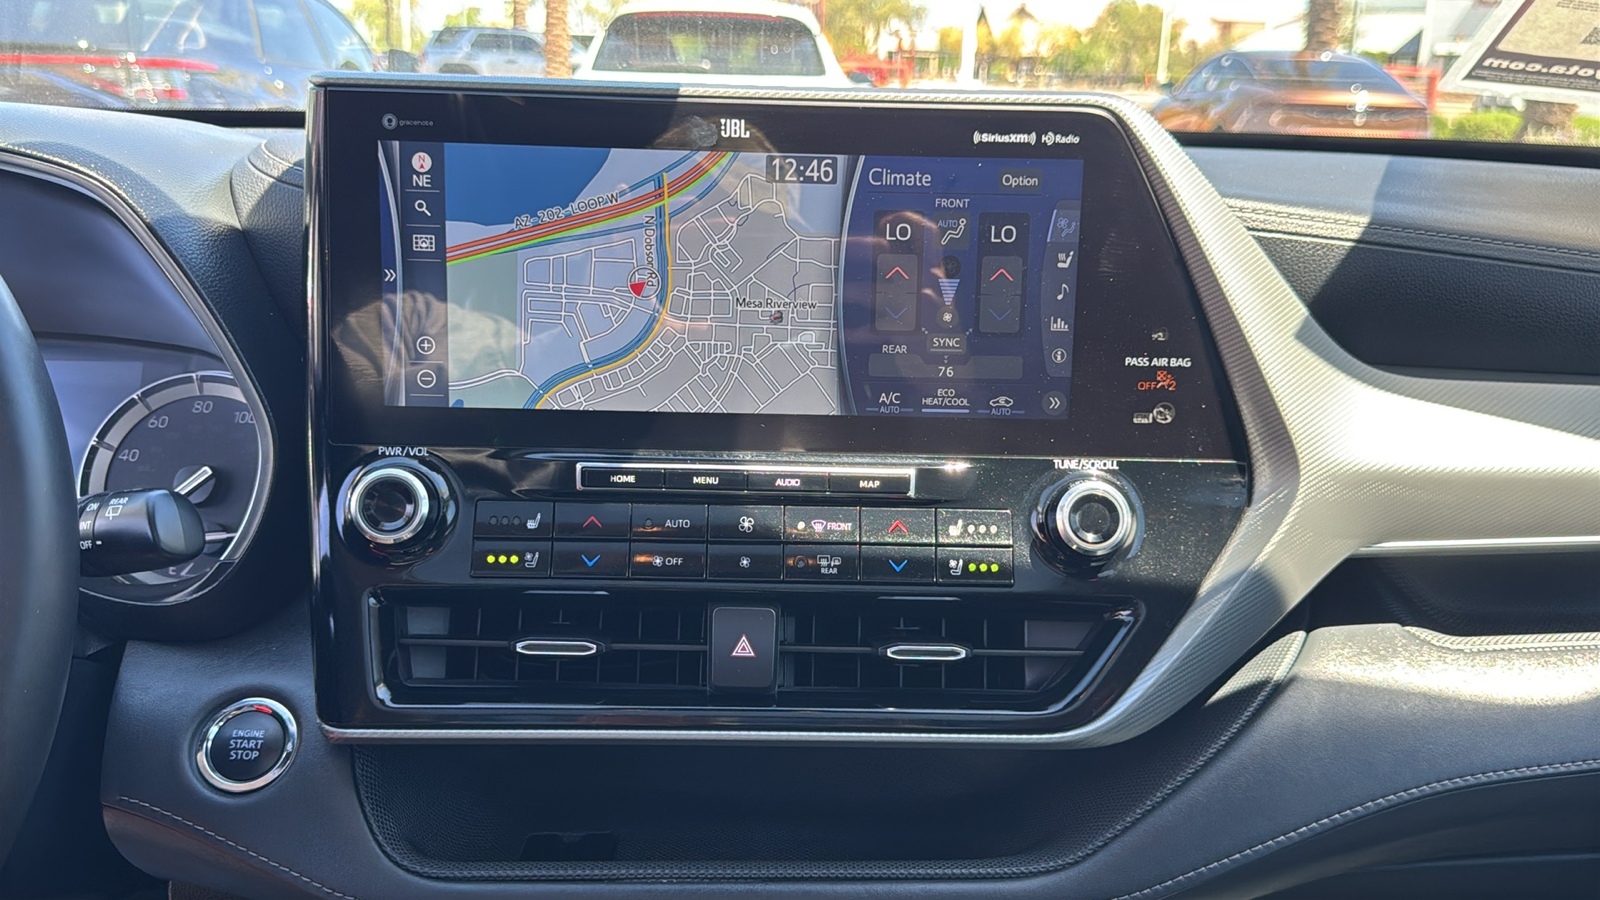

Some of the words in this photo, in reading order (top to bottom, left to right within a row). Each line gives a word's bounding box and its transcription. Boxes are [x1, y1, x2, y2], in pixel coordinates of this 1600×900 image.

[399, 119, 434, 127] gracenote
[720, 118, 751, 139] JBL
[1055, 133, 1080, 144] Radio
[417, 154, 426, 163] N
[771, 158, 834, 183] 12:46
[412, 174, 432, 188] NE
[868, 167, 932, 187] Climate
[1002, 173, 1039, 188] Option
[606, 191, 620, 205] W
[935, 198, 970, 208] FRONT
[644, 215, 655, 225] N
[938, 218, 958, 228] AUTO
[886, 223, 912, 241] LO
[990, 225, 1017, 243] LO
[644, 228, 656, 269] Dobson
[646, 271, 658, 287] Rd
[735, 298, 763, 309] Mesa
[765, 298, 818, 310] Riverview
[933, 337, 961, 348] SYNC
[882, 344, 908, 354] REAR
[1124, 357, 1149, 367] PASS
[1150, 357, 1169, 367] AIR
[1169, 358, 1192, 368] BAG
[937, 366, 954, 378] 76
[1137, 381, 1157, 391] OFF
[878, 391, 901, 405] A/C
[937, 388, 955, 397] ECO
[191, 400, 214, 414] 80
[921, 396, 970, 407] HEAT/COOL
[879, 404, 900, 414] AUTO
[990, 406, 1012, 416] AUTO
[147, 415, 169, 429] 60
[118, 448, 140, 462] 40
[377, 446, 430, 457] PWR/VOL
[1052, 459, 1120, 470] TUNE/SCROLL
[609, 474, 636, 483] HOME
[692, 475, 719, 485] MENU
[775, 478, 801, 487] AUDIO
[859, 480, 881, 489] MAP
[86, 502, 100, 512] ON
[108, 497, 129, 506] REAR
[664, 518, 691, 529] AUTO
[826, 521, 853, 531] FRONT
[79, 540, 93, 550] OFF
[665, 556, 684, 566] OFF
[820, 567, 838, 575] REAR
[232, 729, 266, 739] ENGINE
[228, 739, 265, 750] START
[228, 749, 260, 761] STOP
